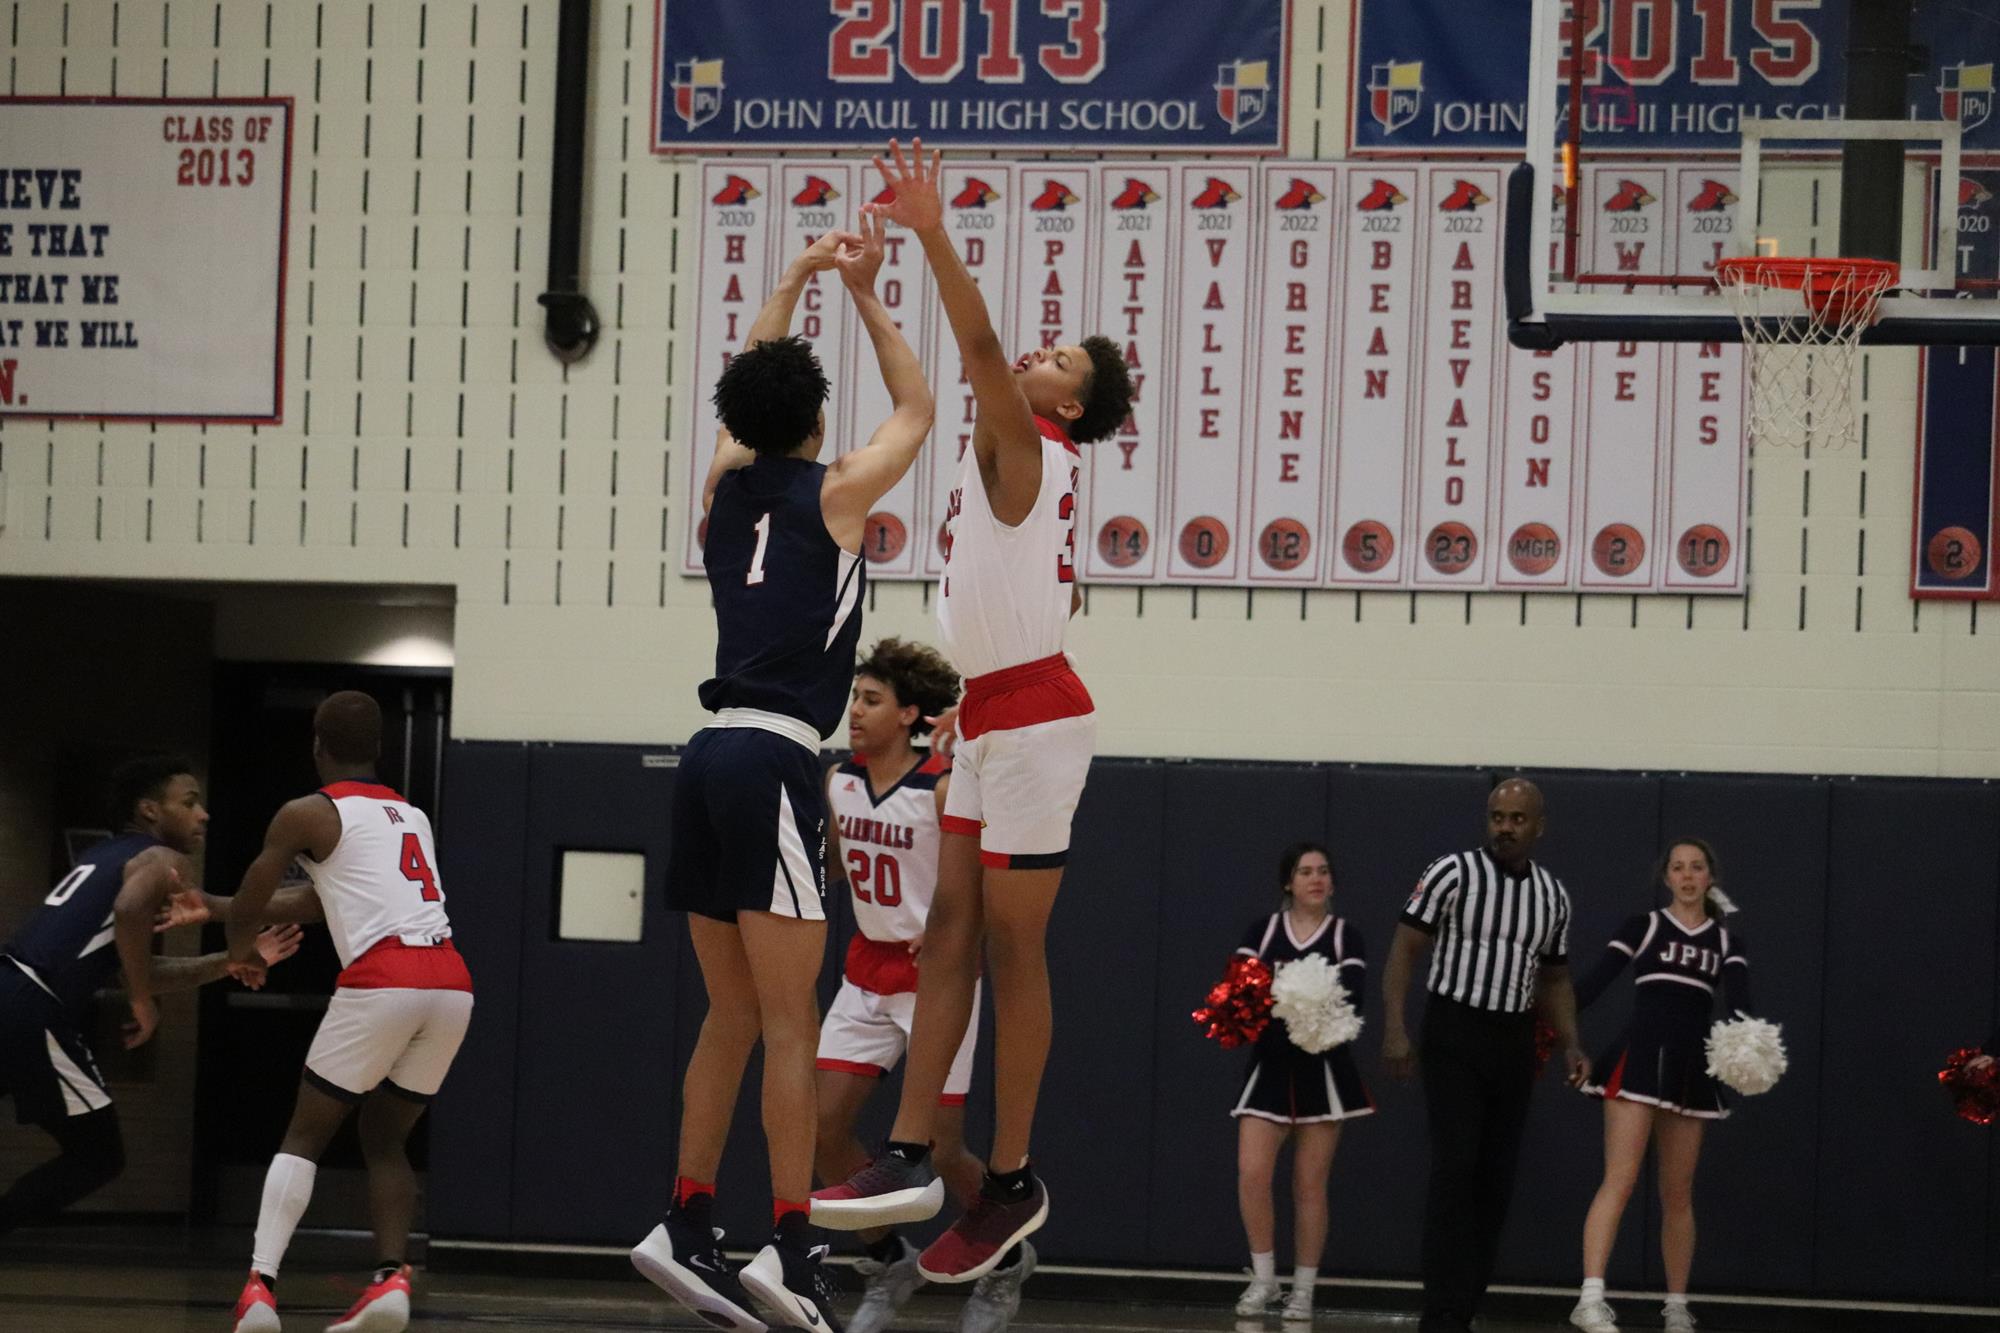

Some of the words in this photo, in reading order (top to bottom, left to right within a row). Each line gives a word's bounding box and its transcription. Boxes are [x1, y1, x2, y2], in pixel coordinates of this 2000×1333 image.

[827, 0, 1107, 84] 2013
[163, 117, 234, 143] CLASS
[245, 116, 273, 143] OF
[733, 98, 823, 134] JOHN
[834, 99, 918, 130] PAUL
[930, 100, 948, 130] II
[961, 99, 1048, 131] HIGH
[1059, 100, 1205, 131] SCHOOL
[1432, 102, 1525, 136] JOHN
[1638, 103, 1656, 133] II
[177, 148, 255, 187] 2013
[717, 211, 756, 227] 2020
[797, 212, 835, 228] 2020
[956, 214, 995, 229] 2020
[1035, 217, 1074, 233] 2020
[1117, 215, 1150, 231] 2021
[1198, 215, 1231, 231] 2021
[1280, 215, 1319, 232] 2022
[1361, 216, 1400, 233] 2022
[1444, 216, 1483, 233] 2022
[1609, 217, 1648, 234] 2023
[1692, 217, 1733, 234] 2023
[28, 223, 110, 258] THAT
[0, 274, 69, 304] THAT
[81, 275, 119, 305] WE
[1364, 240, 1393, 399] BEAN
[35, 320, 69, 348] WE
[80, 320, 138, 349] WILL
[1200, 238, 1227, 438] VALLE
[1279, 239, 1309, 483] GREENE
[1445, 241, 1475, 506] AREVALO
[746, 511, 771, 586] 1
[876, 525, 888, 553] 1
[1109, 530, 1142, 558] 14
[1269, 532, 1301, 561] 12
[1360, 534, 1379, 562] 5
[1434, 536, 1471, 563] 23
[1513, 540, 1556, 558] MGR
[1608, 538, 1628, 566] 2
[1687, 539, 1721, 567] 10
[1944, 540, 1963, 568] 2
[399, 832, 441, 902] 4
[847, 848, 902, 907] 20
[44, 863, 97, 907] 0
